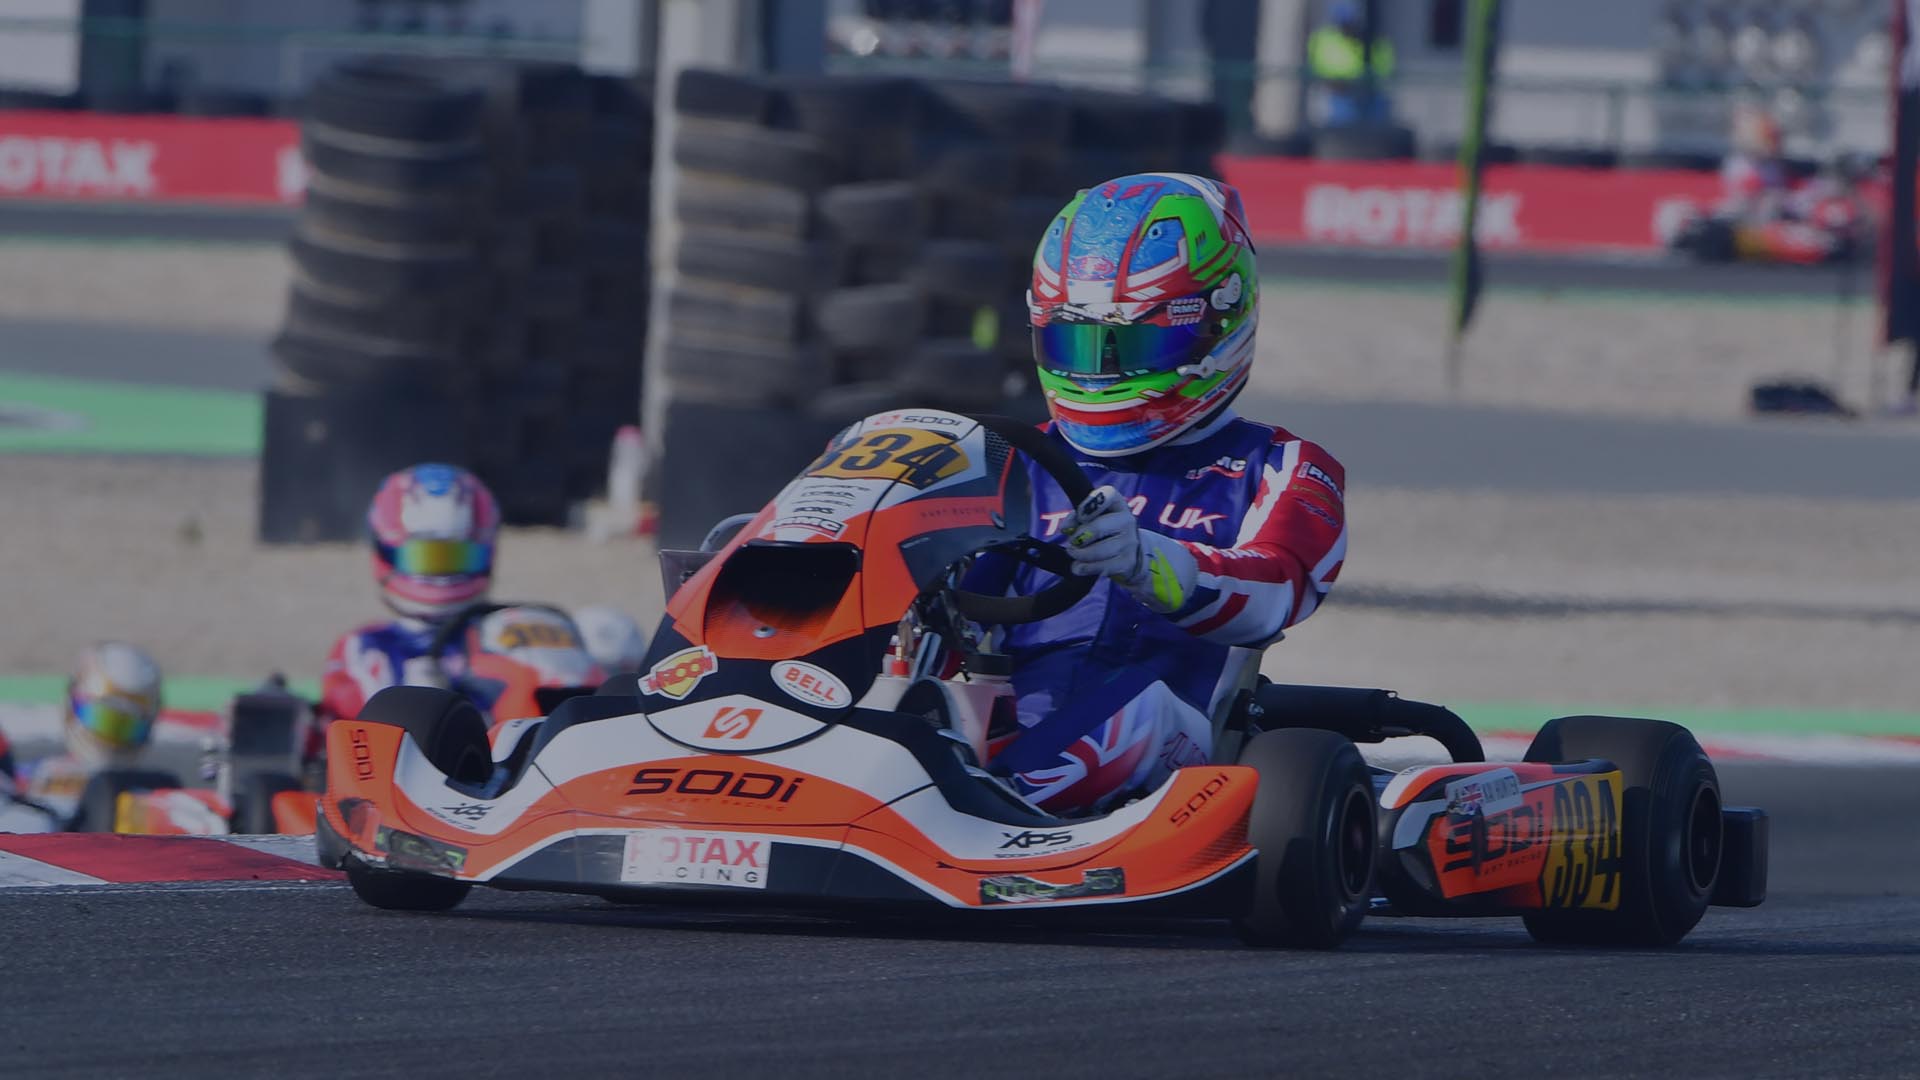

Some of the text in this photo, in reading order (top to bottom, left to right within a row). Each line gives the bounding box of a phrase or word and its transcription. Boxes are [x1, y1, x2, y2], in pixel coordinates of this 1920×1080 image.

[1172, 305, 1201, 314] RMC
[1159, 502, 1228, 535] UK
[784, 667, 835, 701] BELL
[998, 830, 1073, 849] XPS
[1552, 778, 1622, 906] 334
